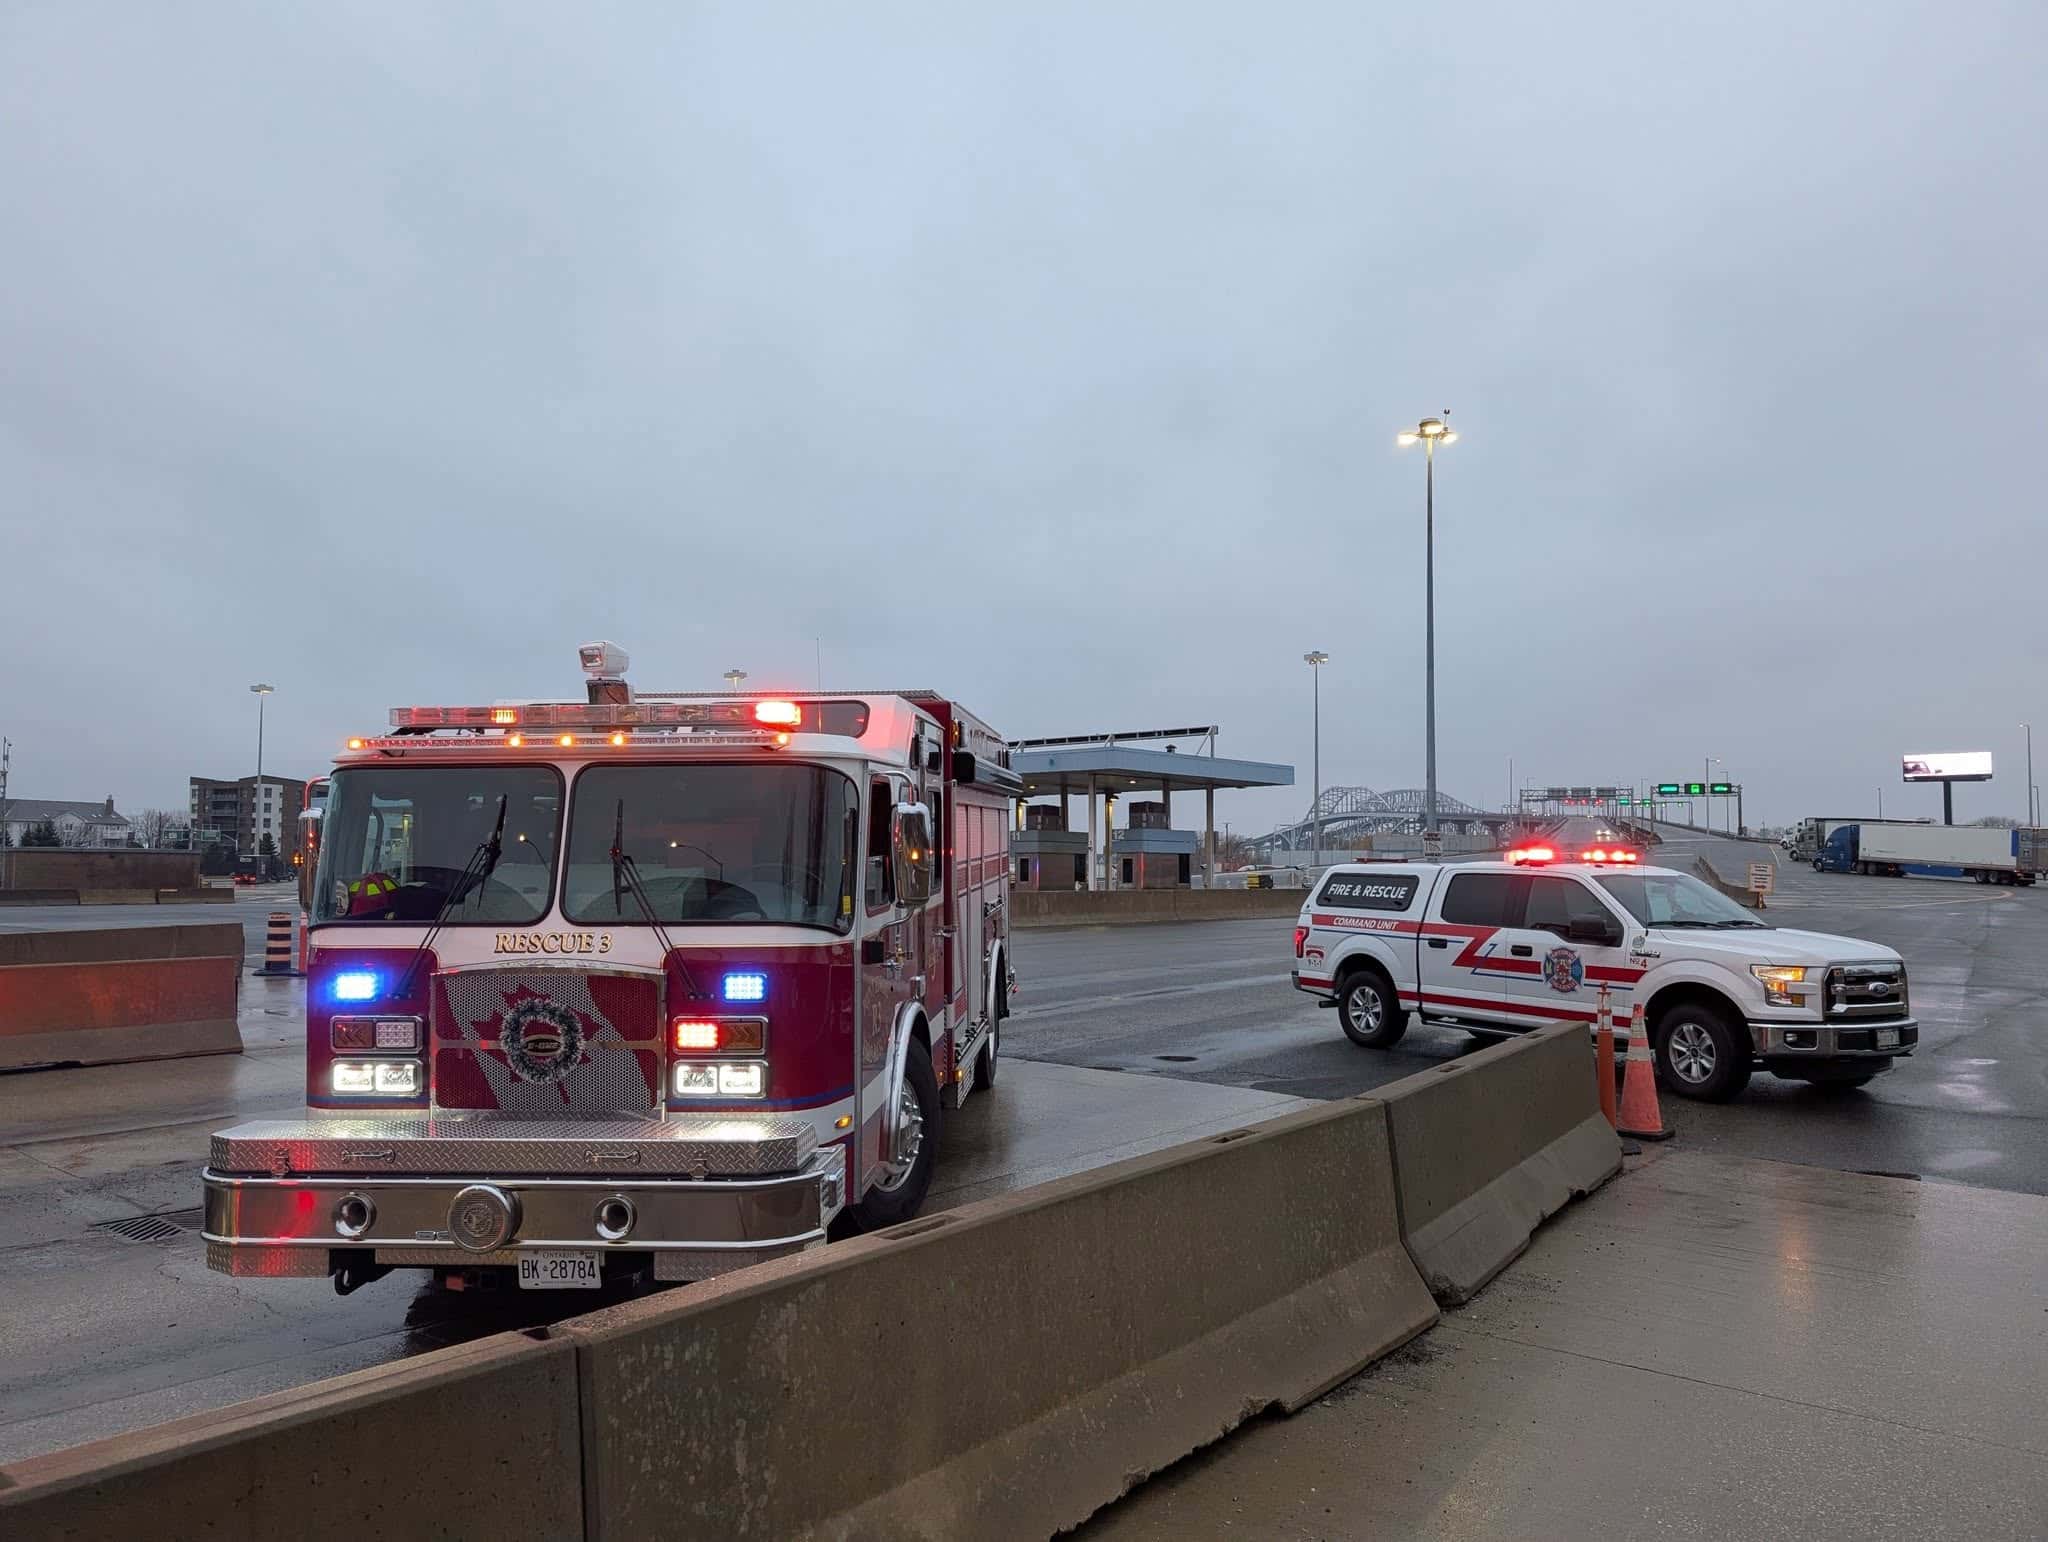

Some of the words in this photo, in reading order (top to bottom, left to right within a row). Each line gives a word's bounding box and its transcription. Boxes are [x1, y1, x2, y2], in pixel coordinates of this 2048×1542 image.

[1327, 883, 1353, 896] FIRE
[1352, 885, 1362, 897] &
[1362, 885, 1409, 899] RESCUE
[1333, 917, 1377, 929] COMMAND
[1376, 920, 1399, 931] UNIT
[494, 932, 594, 953] RESCUE
[599, 933, 613, 953] 3
[1640, 958, 1648, 968] 4
[521, 1259, 540, 1279] BK
[549, 1260, 596, 1279] 28784
